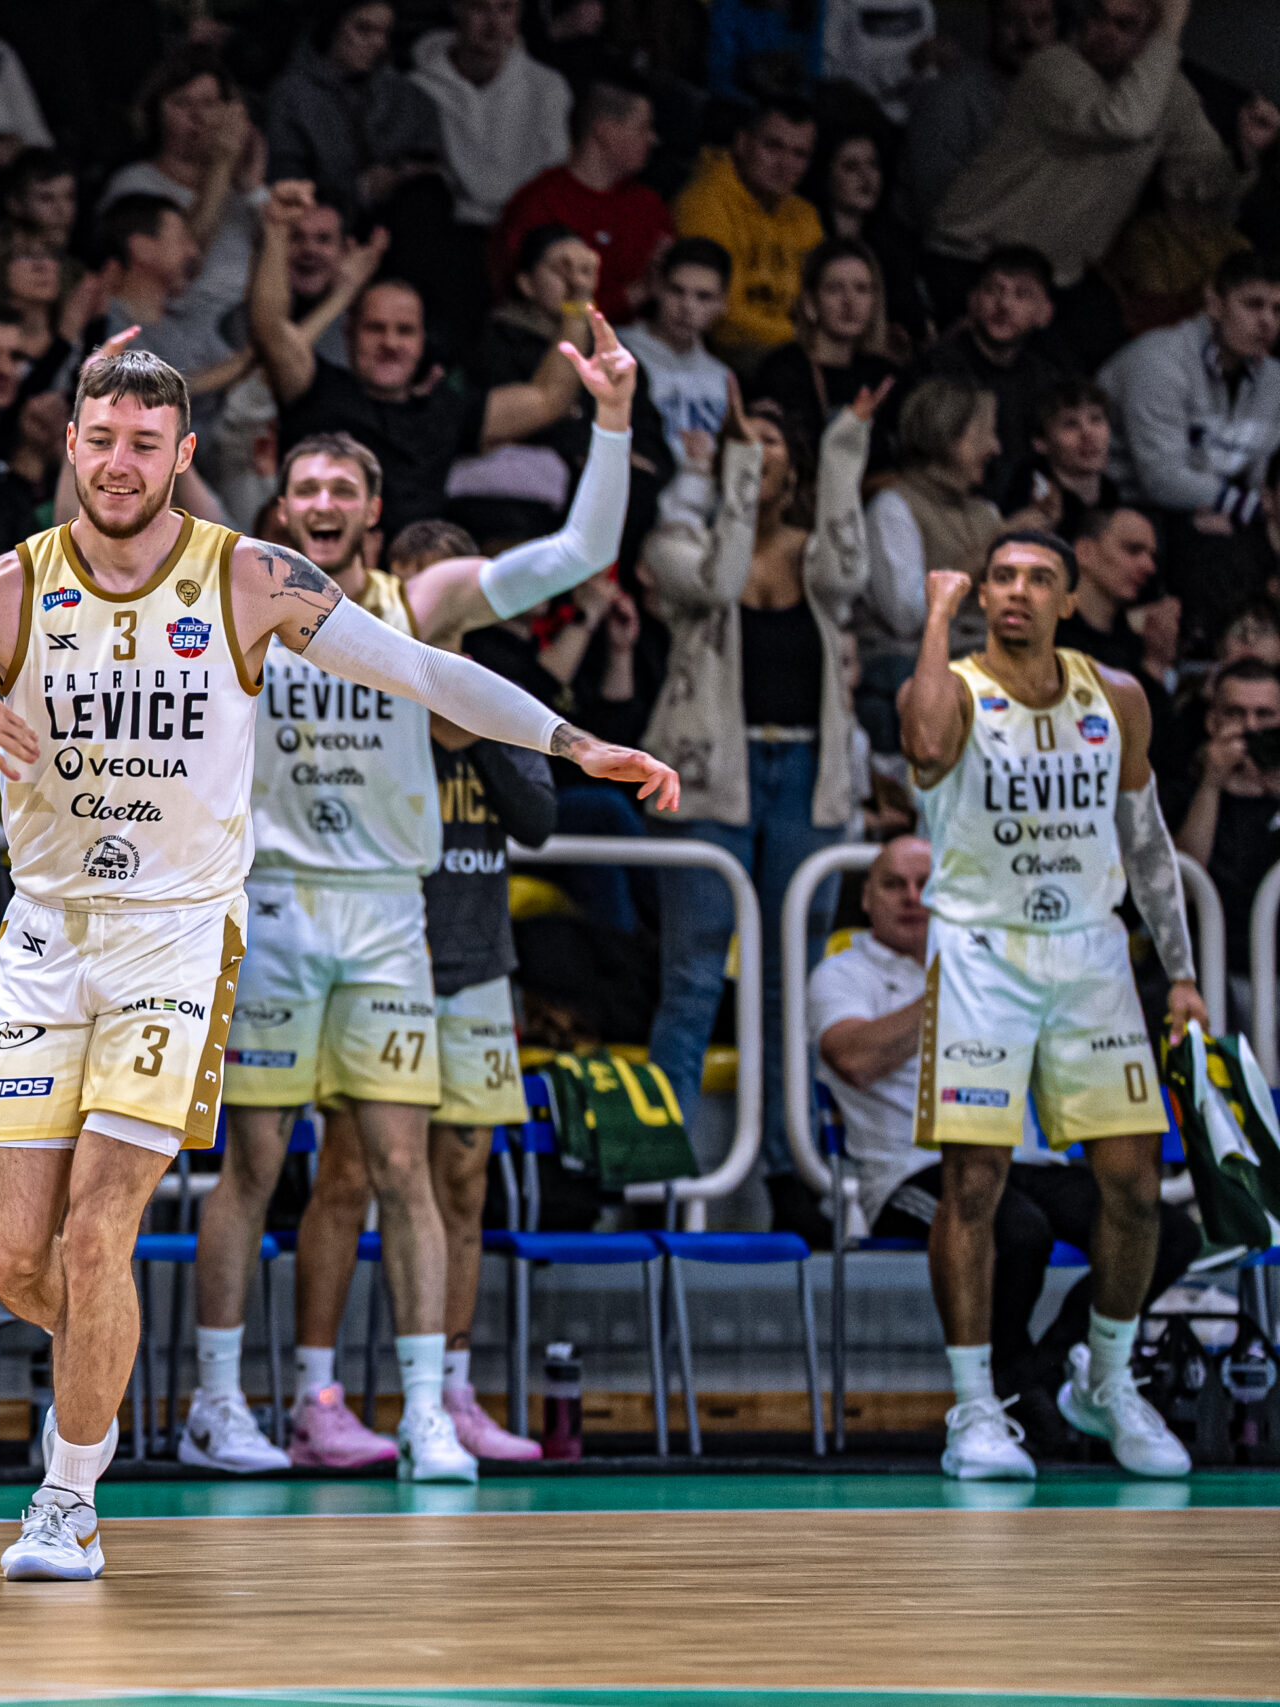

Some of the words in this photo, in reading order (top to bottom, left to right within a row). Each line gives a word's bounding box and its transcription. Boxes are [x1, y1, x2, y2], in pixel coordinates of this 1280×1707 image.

[113, 610, 138, 661] 3
[171, 634, 207, 648] SBL
[179, 624, 210, 633] TIPOS
[44, 669, 209, 694] PATRIOTI
[45, 691, 208, 740] LEVICE
[267, 682, 394, 721] LEVICE
[303, 732, 383, 751] VEOLIA
[1033, 714, 1056, 752] 0
[88, 757, 188, 778] VEOLIA
[70, 793, 163, 822] Cloetta
[984, 770, 1109, 812] LEVICE
[87, 865, 128, 880] ŠEBO
[133, 1024, 171, 1077] 3
[194, 955, 243, 1115] LEVICE
[379, 1030, 426, 1073] 47
[483, 1048, 518, 1090] 34
